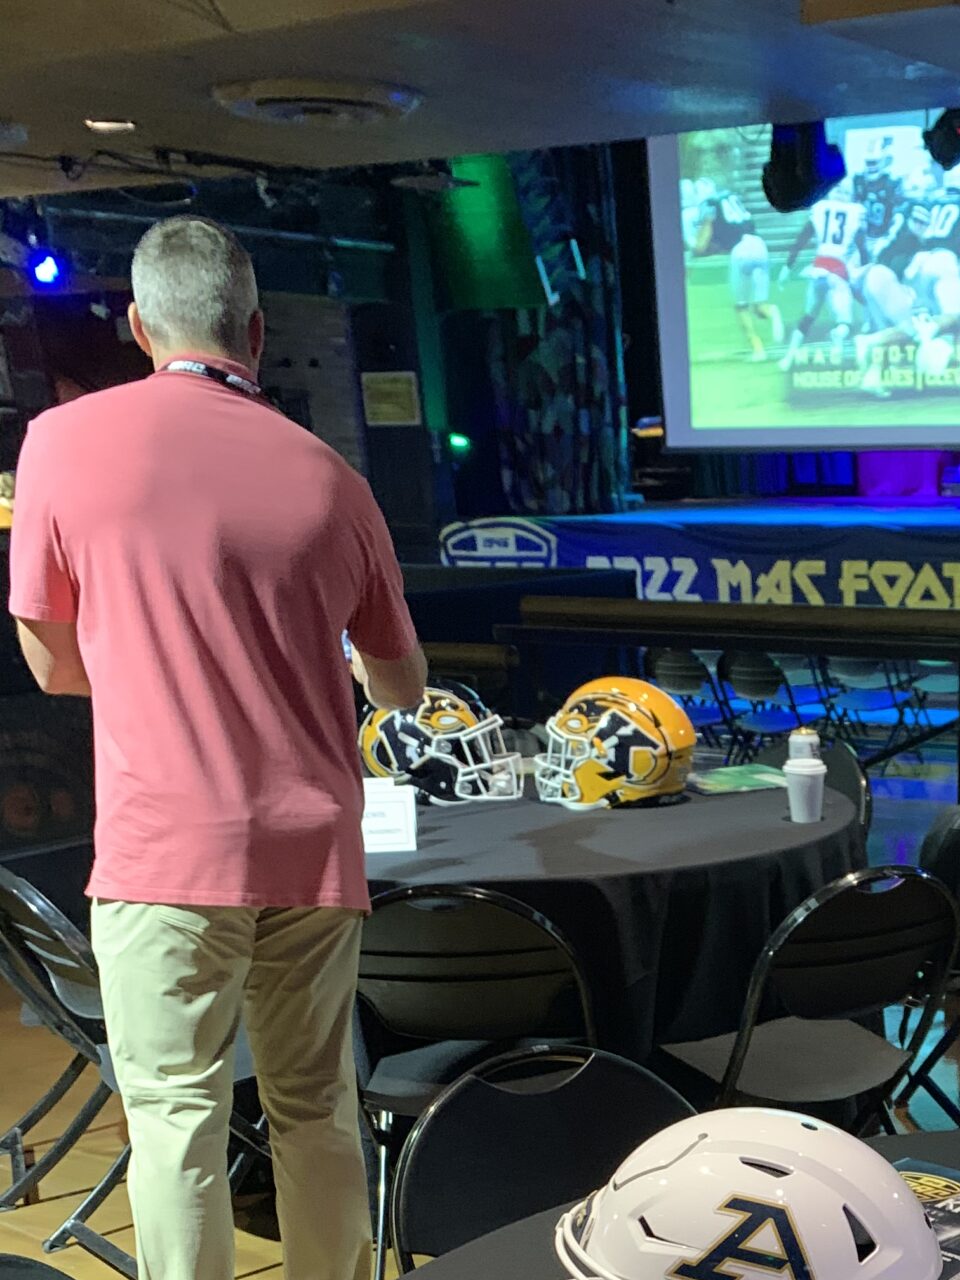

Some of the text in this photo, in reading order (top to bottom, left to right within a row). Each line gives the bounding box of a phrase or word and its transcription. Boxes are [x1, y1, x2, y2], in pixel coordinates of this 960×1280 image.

[822, 209, 846, 245] 13
[586, 555, 702, 601] 22
[711, 558, 826, 606] MAC
